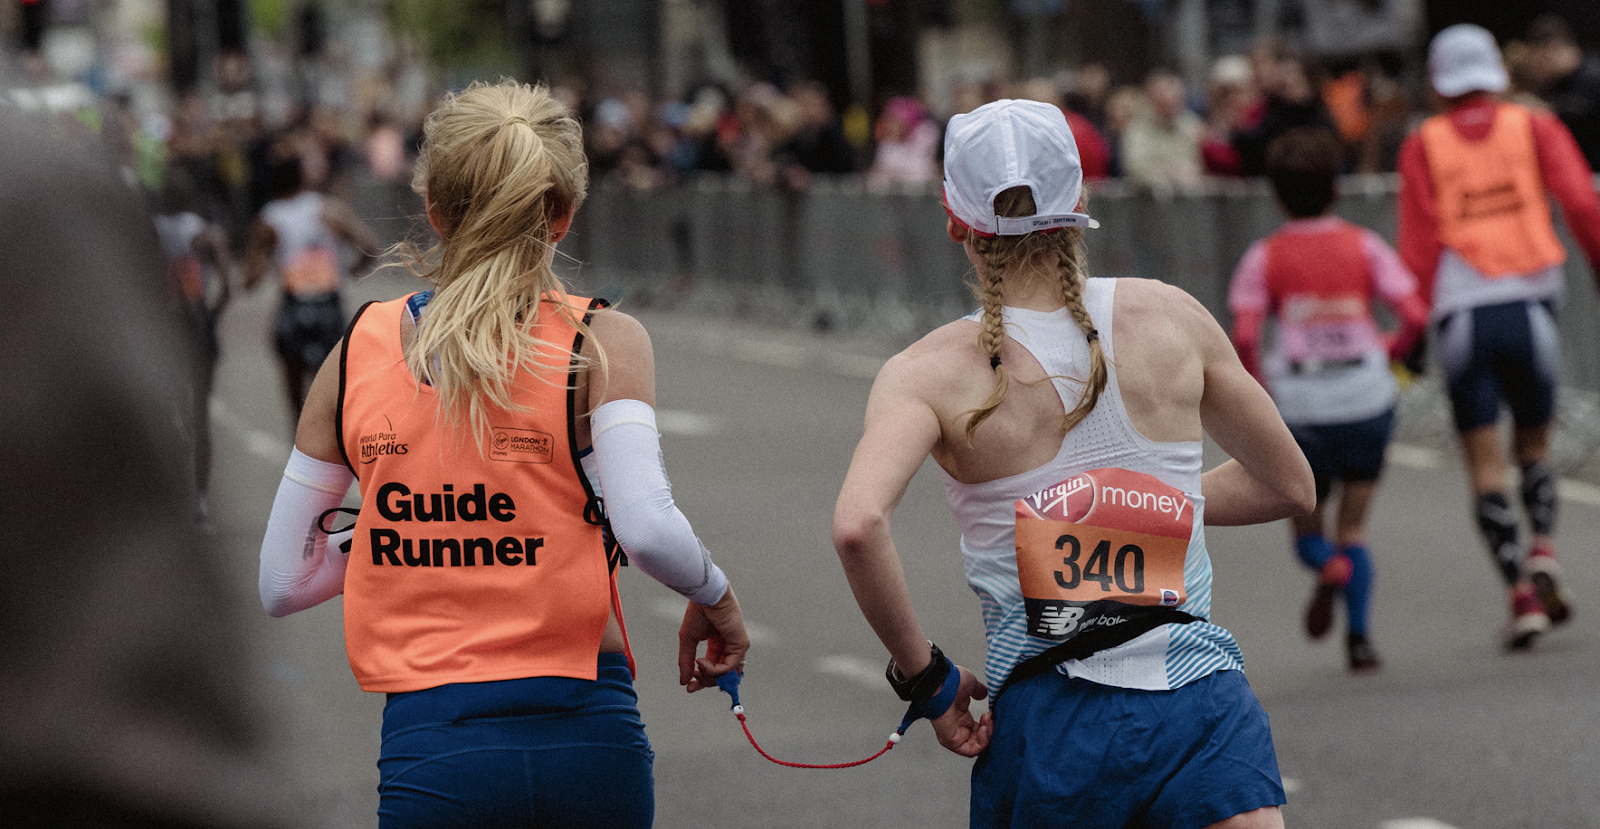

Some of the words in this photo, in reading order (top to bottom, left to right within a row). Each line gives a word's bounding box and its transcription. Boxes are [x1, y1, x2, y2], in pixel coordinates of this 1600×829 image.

[362, 441, 408, 458] Athletics
[378, 432, 396, 441] Para
[511, 436, 540, 444] LONDON
[511, 444, 549, 453] MARATHON
[376, 482, 516, 522] Guide
[1027, 476, 1090, 516] Virgin
[1102, 486, 1187, 521] money
[370, 528, 544, 567] Runner
[1053, 534, 1145, 594] 340
